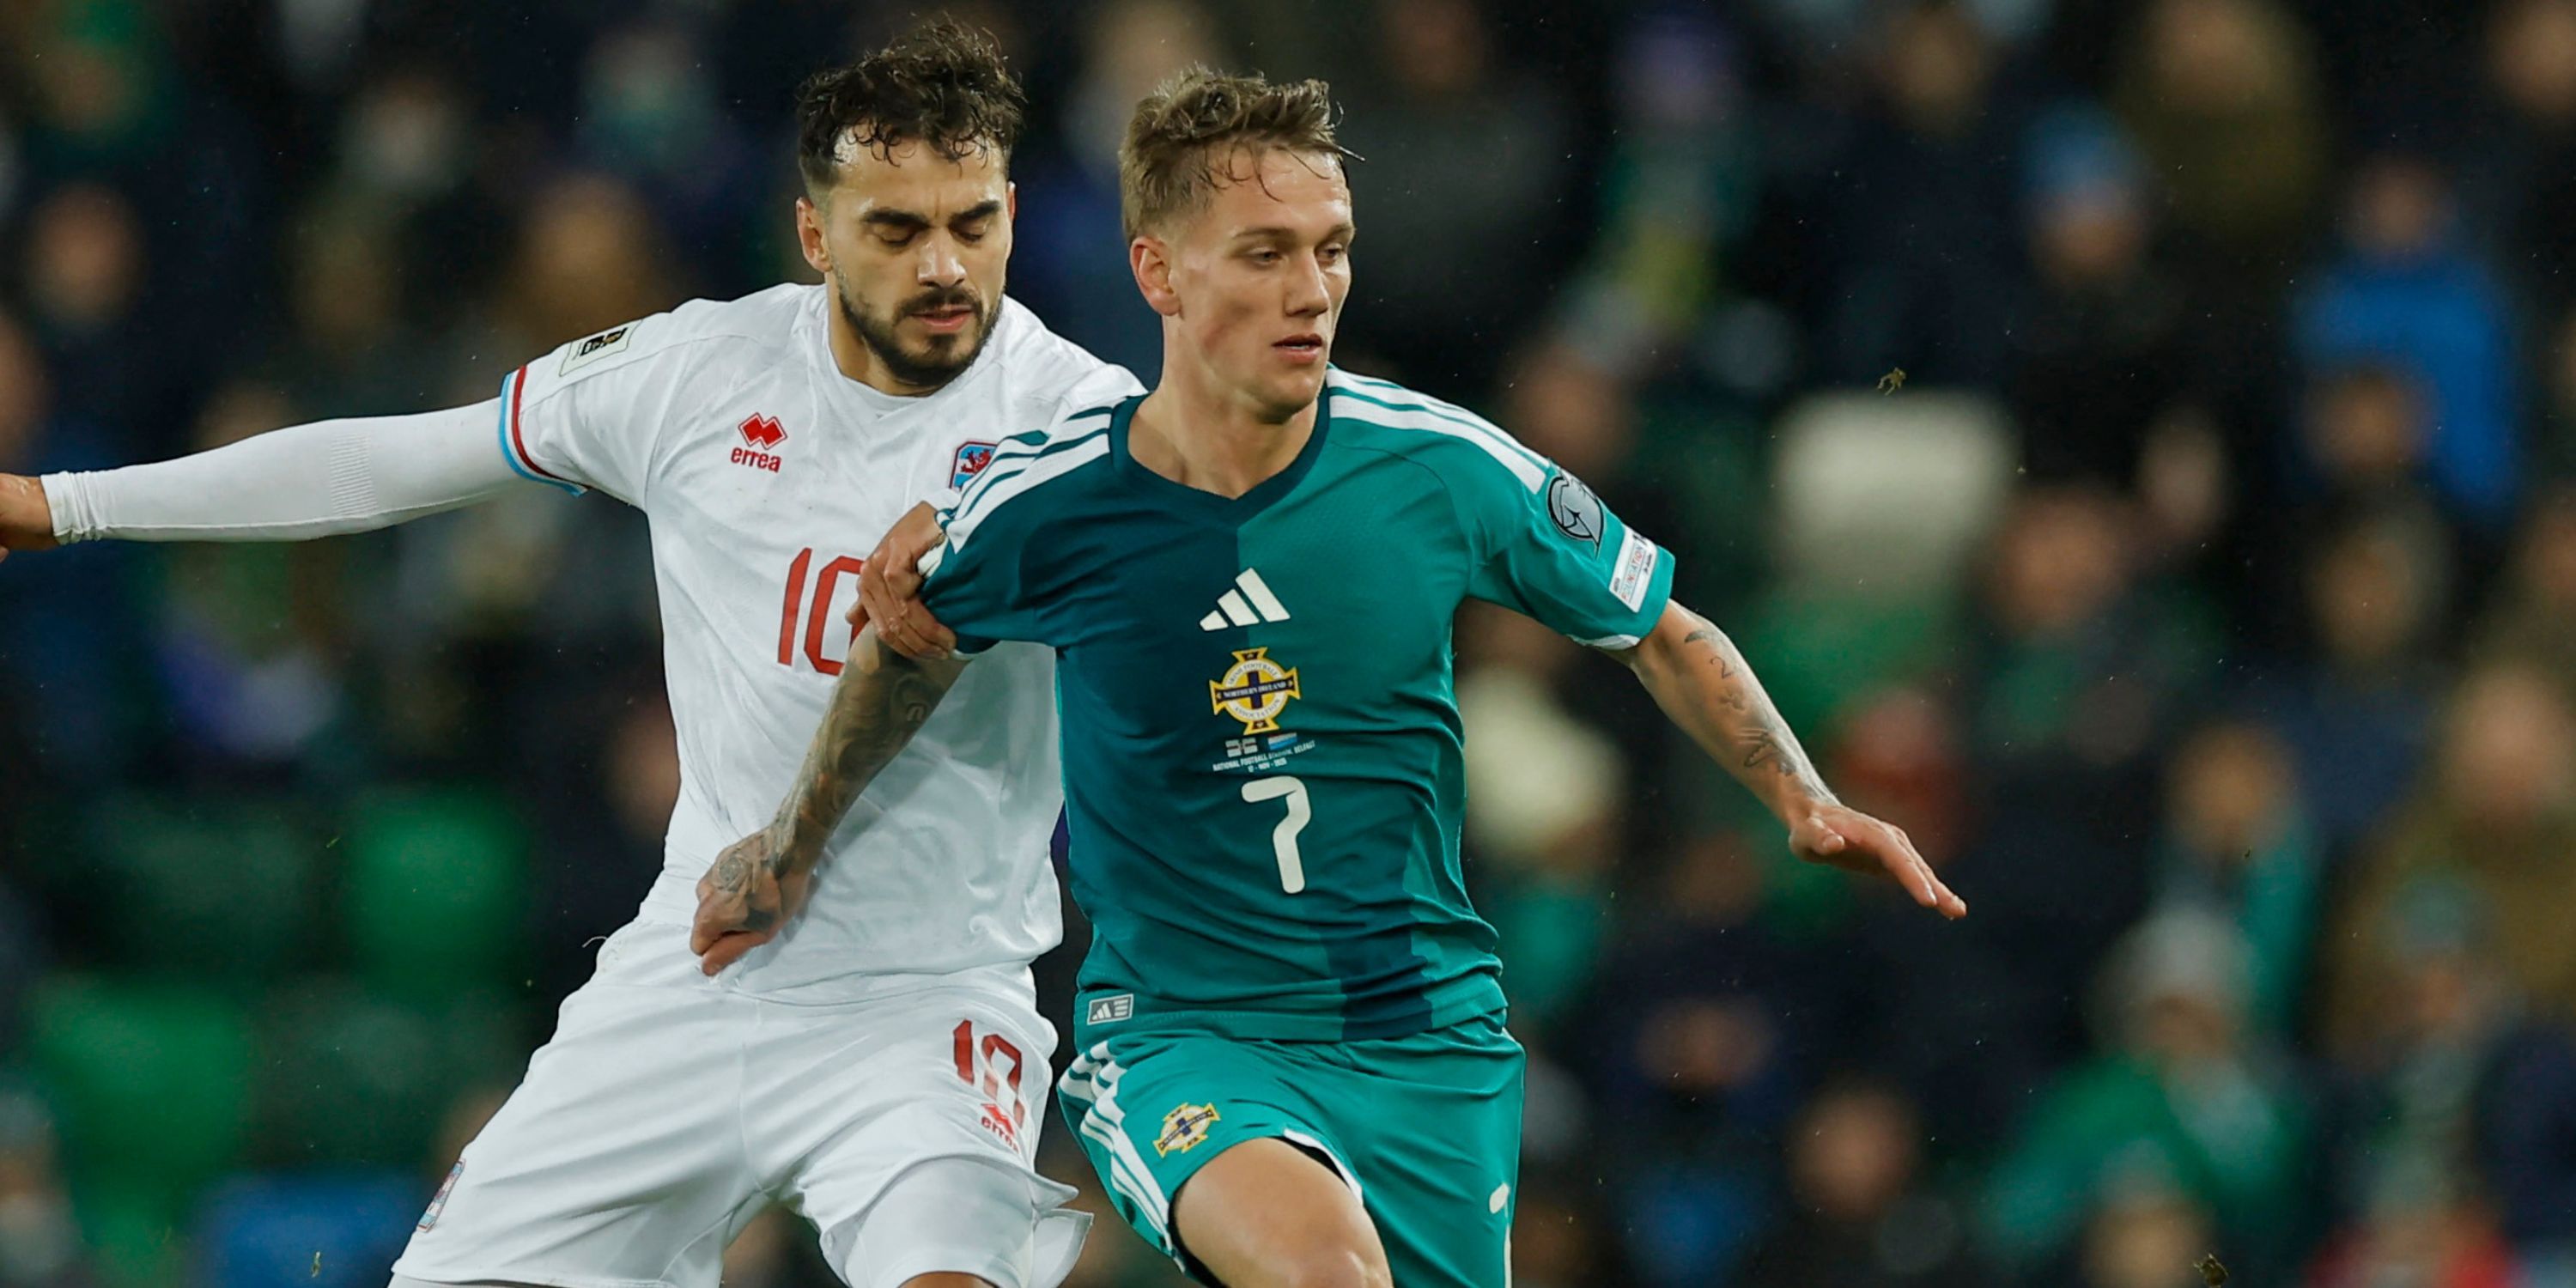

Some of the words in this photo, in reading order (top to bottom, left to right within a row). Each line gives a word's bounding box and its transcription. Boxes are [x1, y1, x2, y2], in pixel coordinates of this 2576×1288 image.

[731, 447, 781, 472] errea
[778, 547, 870, 676] 10
[1223, 686, 1258, 698] NORTHERN
[1258, 681, 1286, 692] IRELAND
[1212, 759, 1240, 771] NATIONAL
[1240, 753, 1267, 766] FOOTBALL
[1241, 775, 1311, 896] 7
[953, 1019, 1025, 1130] 10
